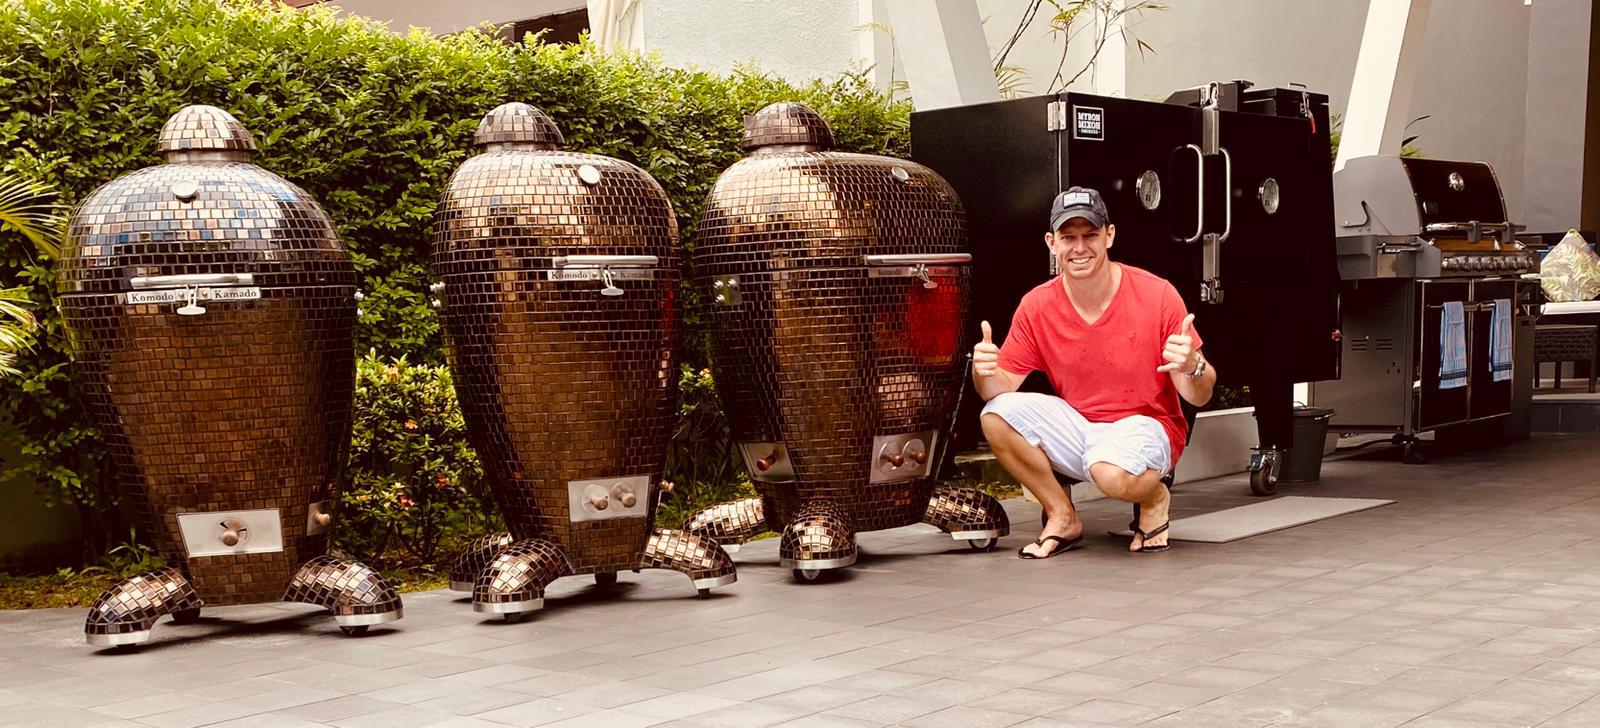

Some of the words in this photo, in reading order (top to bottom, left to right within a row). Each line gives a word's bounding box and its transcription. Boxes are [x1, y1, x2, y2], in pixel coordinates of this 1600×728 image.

[1078, 112, 1100, 121] MYRON
[1078, 120, 1100, 129] MIXON
[552, 271, 588, 279] Komodo
[132, 292, 174, 302] Komodo
[215, 289, 257, 298] Kamado
